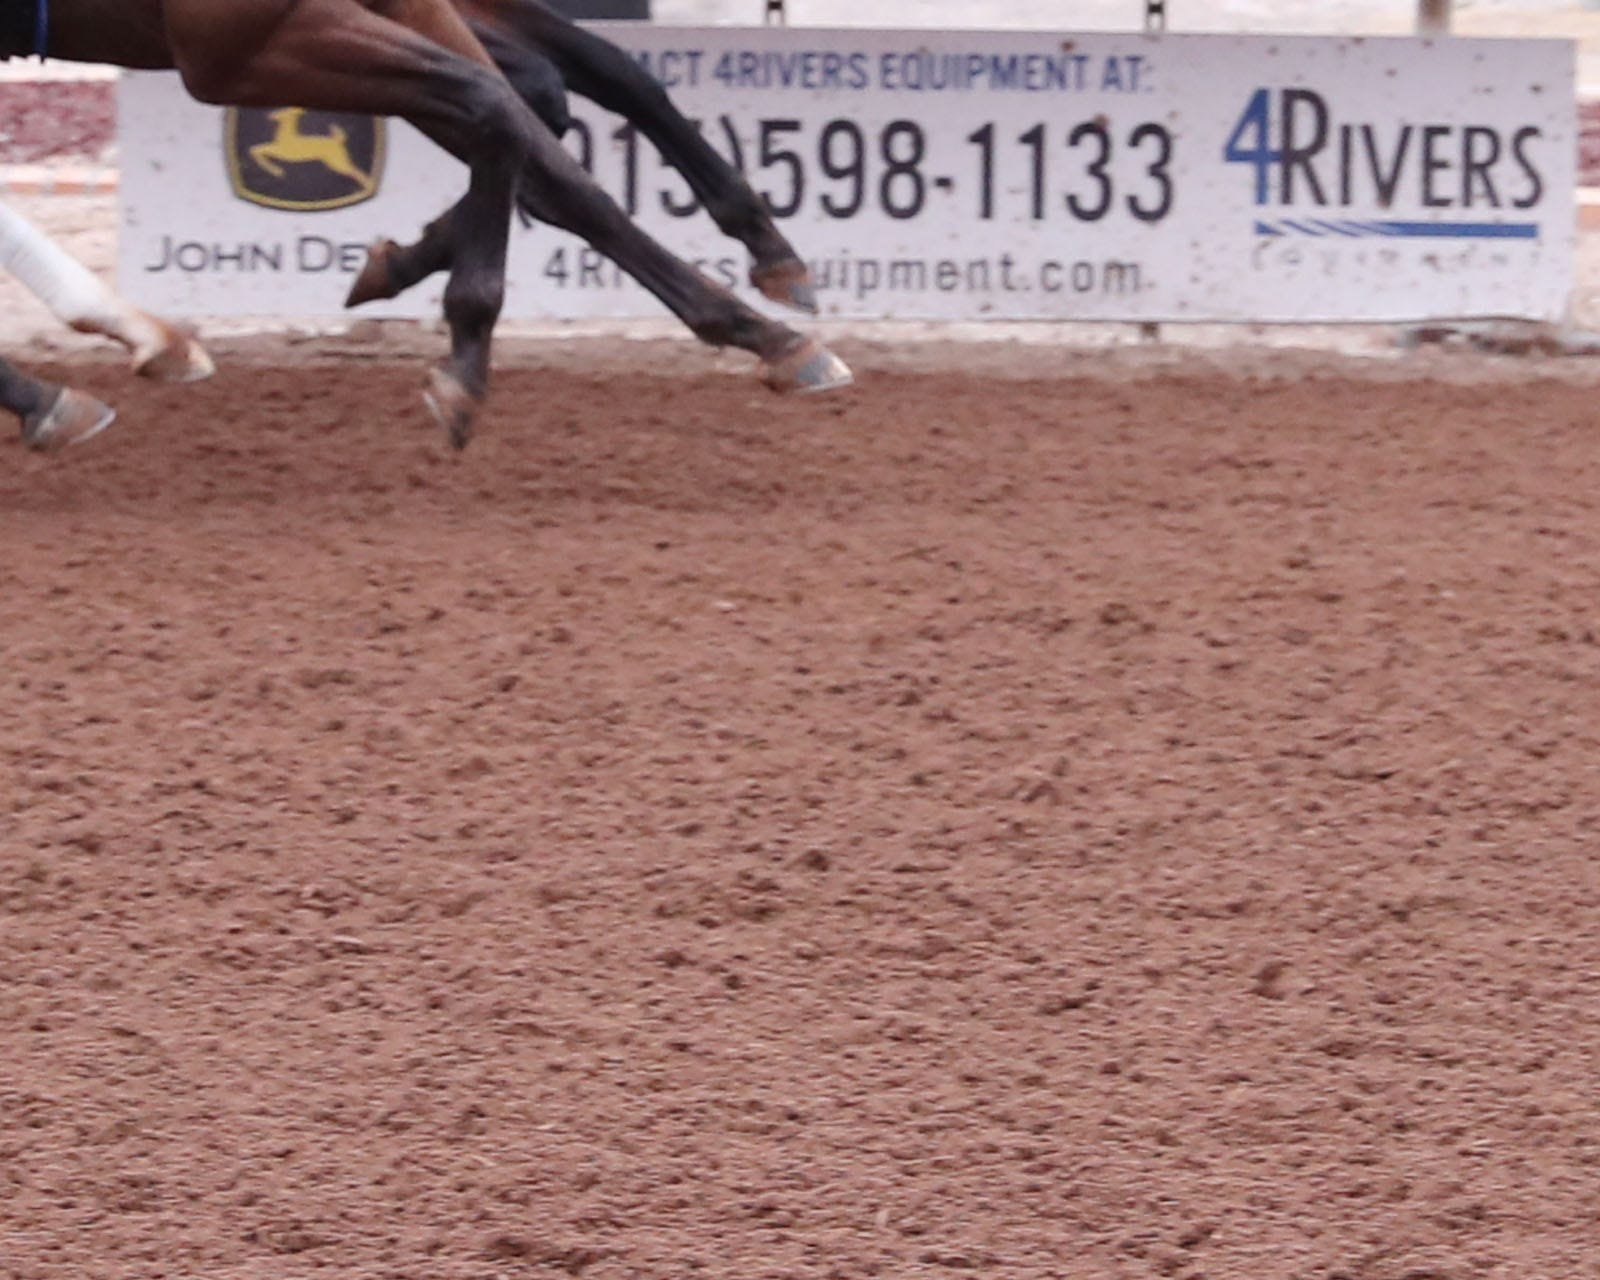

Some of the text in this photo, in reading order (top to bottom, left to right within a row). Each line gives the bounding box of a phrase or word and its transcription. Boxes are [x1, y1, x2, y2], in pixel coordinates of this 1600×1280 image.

[713, 49, 869, 90] 4RIVERS
[880, 52, 1089, 91] EQUIPMENT
[1223, 87, 1545, 210] 4RIVERS
[144, 234, 282, 273] JOHN
